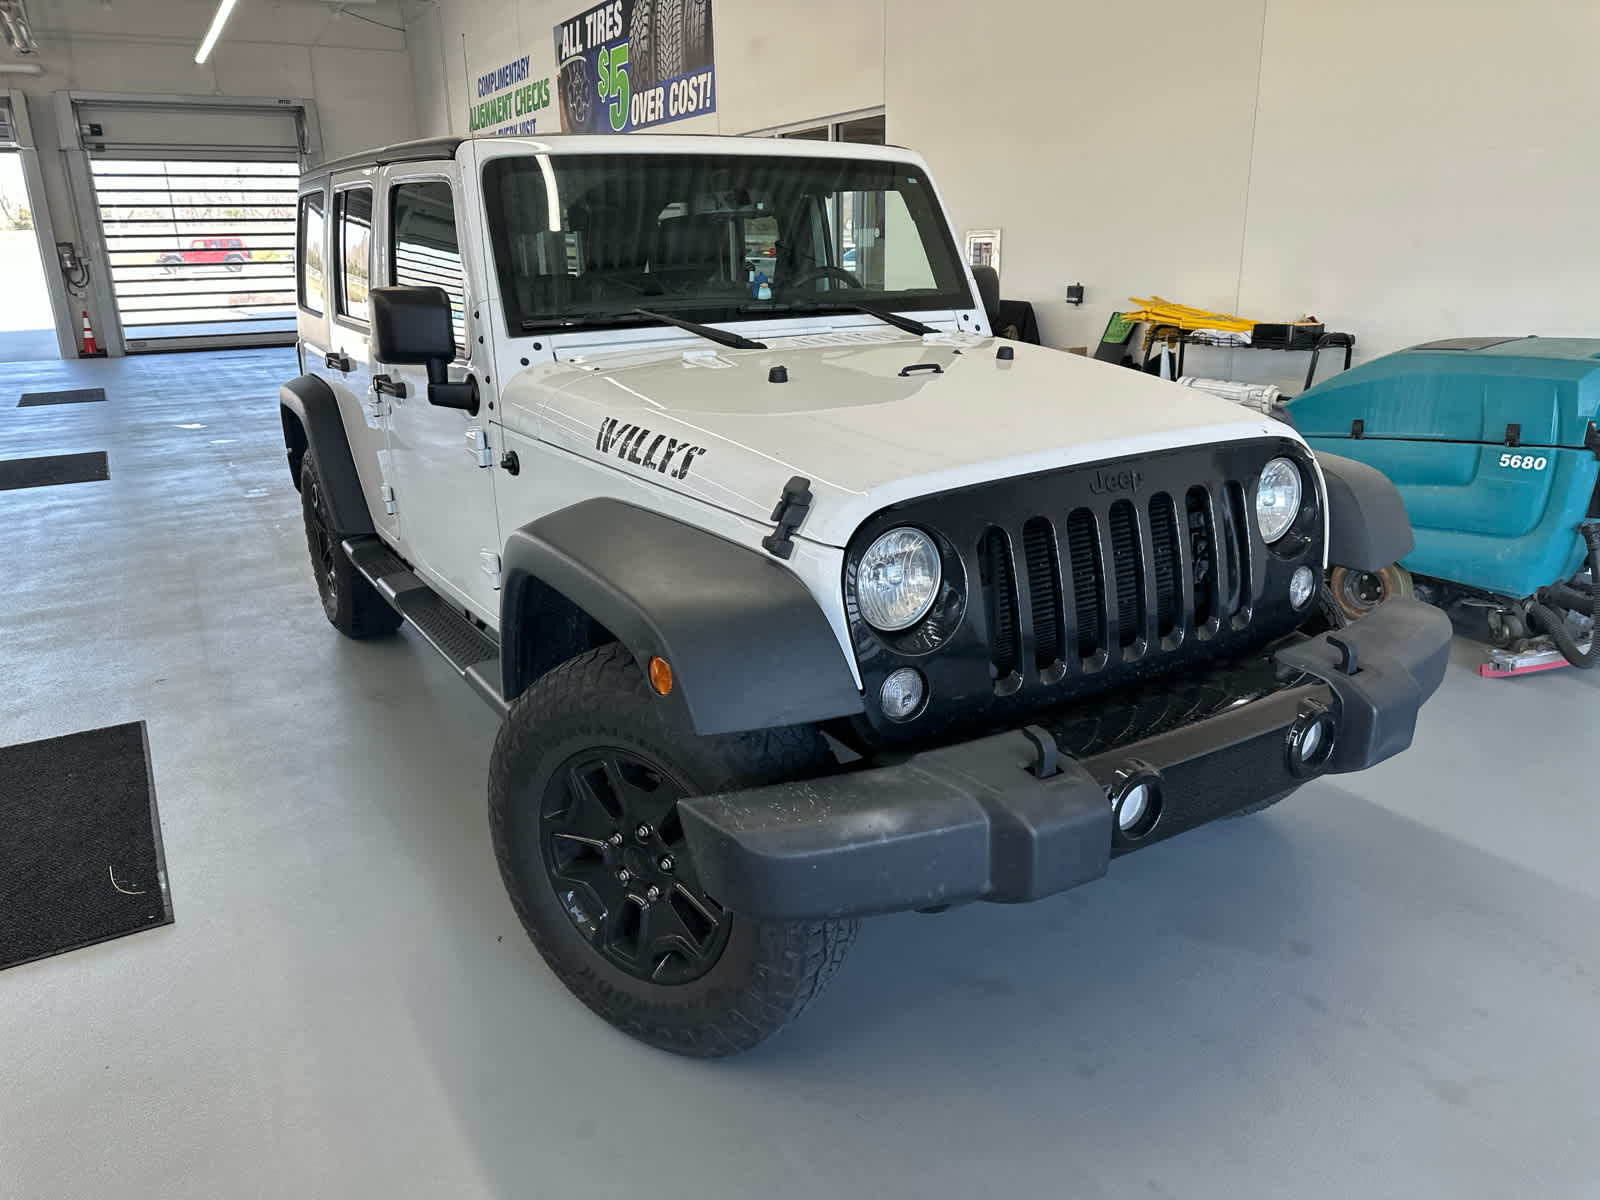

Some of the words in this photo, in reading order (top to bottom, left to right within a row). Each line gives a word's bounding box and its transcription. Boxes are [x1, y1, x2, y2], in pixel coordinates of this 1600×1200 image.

[561, 20, 583, 60] ALL
[585, 0, 623, 49] TIRES
[478, 55, 530, 98] COMPLIMENTARY
[597, 42, 629, 132] $5
[631, 86, 665, 126] OVER
[669, 71, 712, 117] COST!
[469, 91, 513, 132] ALIGNMENT
[514, 78, 550, 117] CHECKS
[596, 416, 706, 480] WILLYS
[1499, 453, 1547, 471] 5680
[1089, 469, 1144, 495] Jeep
